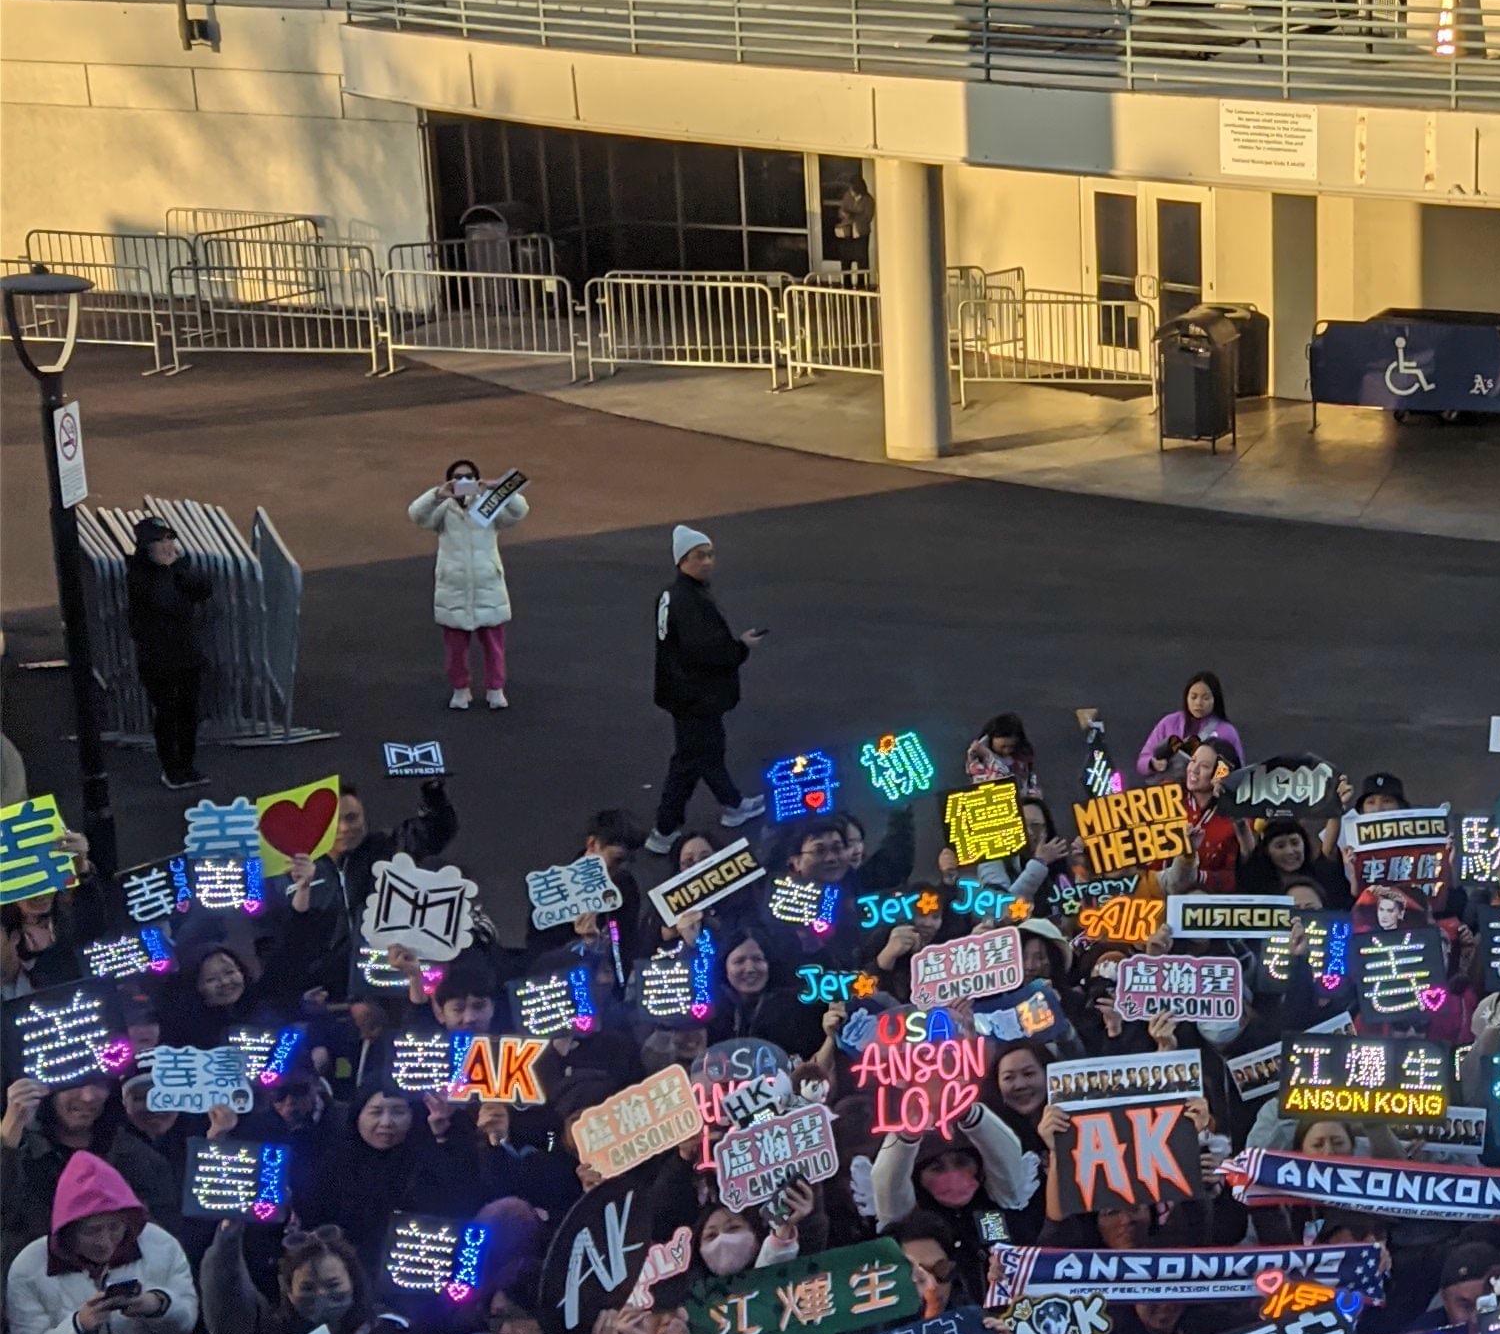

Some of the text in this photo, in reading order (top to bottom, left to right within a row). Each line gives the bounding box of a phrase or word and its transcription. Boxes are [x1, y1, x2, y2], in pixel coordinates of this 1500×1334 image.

[1073, 783, 1188, 838] MIRROR
[1084, 819, 1194, 875] THE BEST
[951, 880, 1015, 920] Jer
[1047, 874, 1141, 905] Jeremy
[857, 892, 920, 929] Jer
[796, 964, 858, 1005] Jer
[998, 966, 1018, 986] LO
[876, 1007, 953, 1044] USA
[1145, 997, 1237, 1017] ANSON LO
[449, 1035, 551, 1105] AK
[851, 1036, 987, 1088] ANSON
[725, 1082, 775, 1120] HK
[871, 1085, 928, 1138] LO
[1284, 1088, 1444, 1116] ANSON KONG
[1071, 1104, 1195, 1212] AK
[557, 1189, 645, 1331] AK
